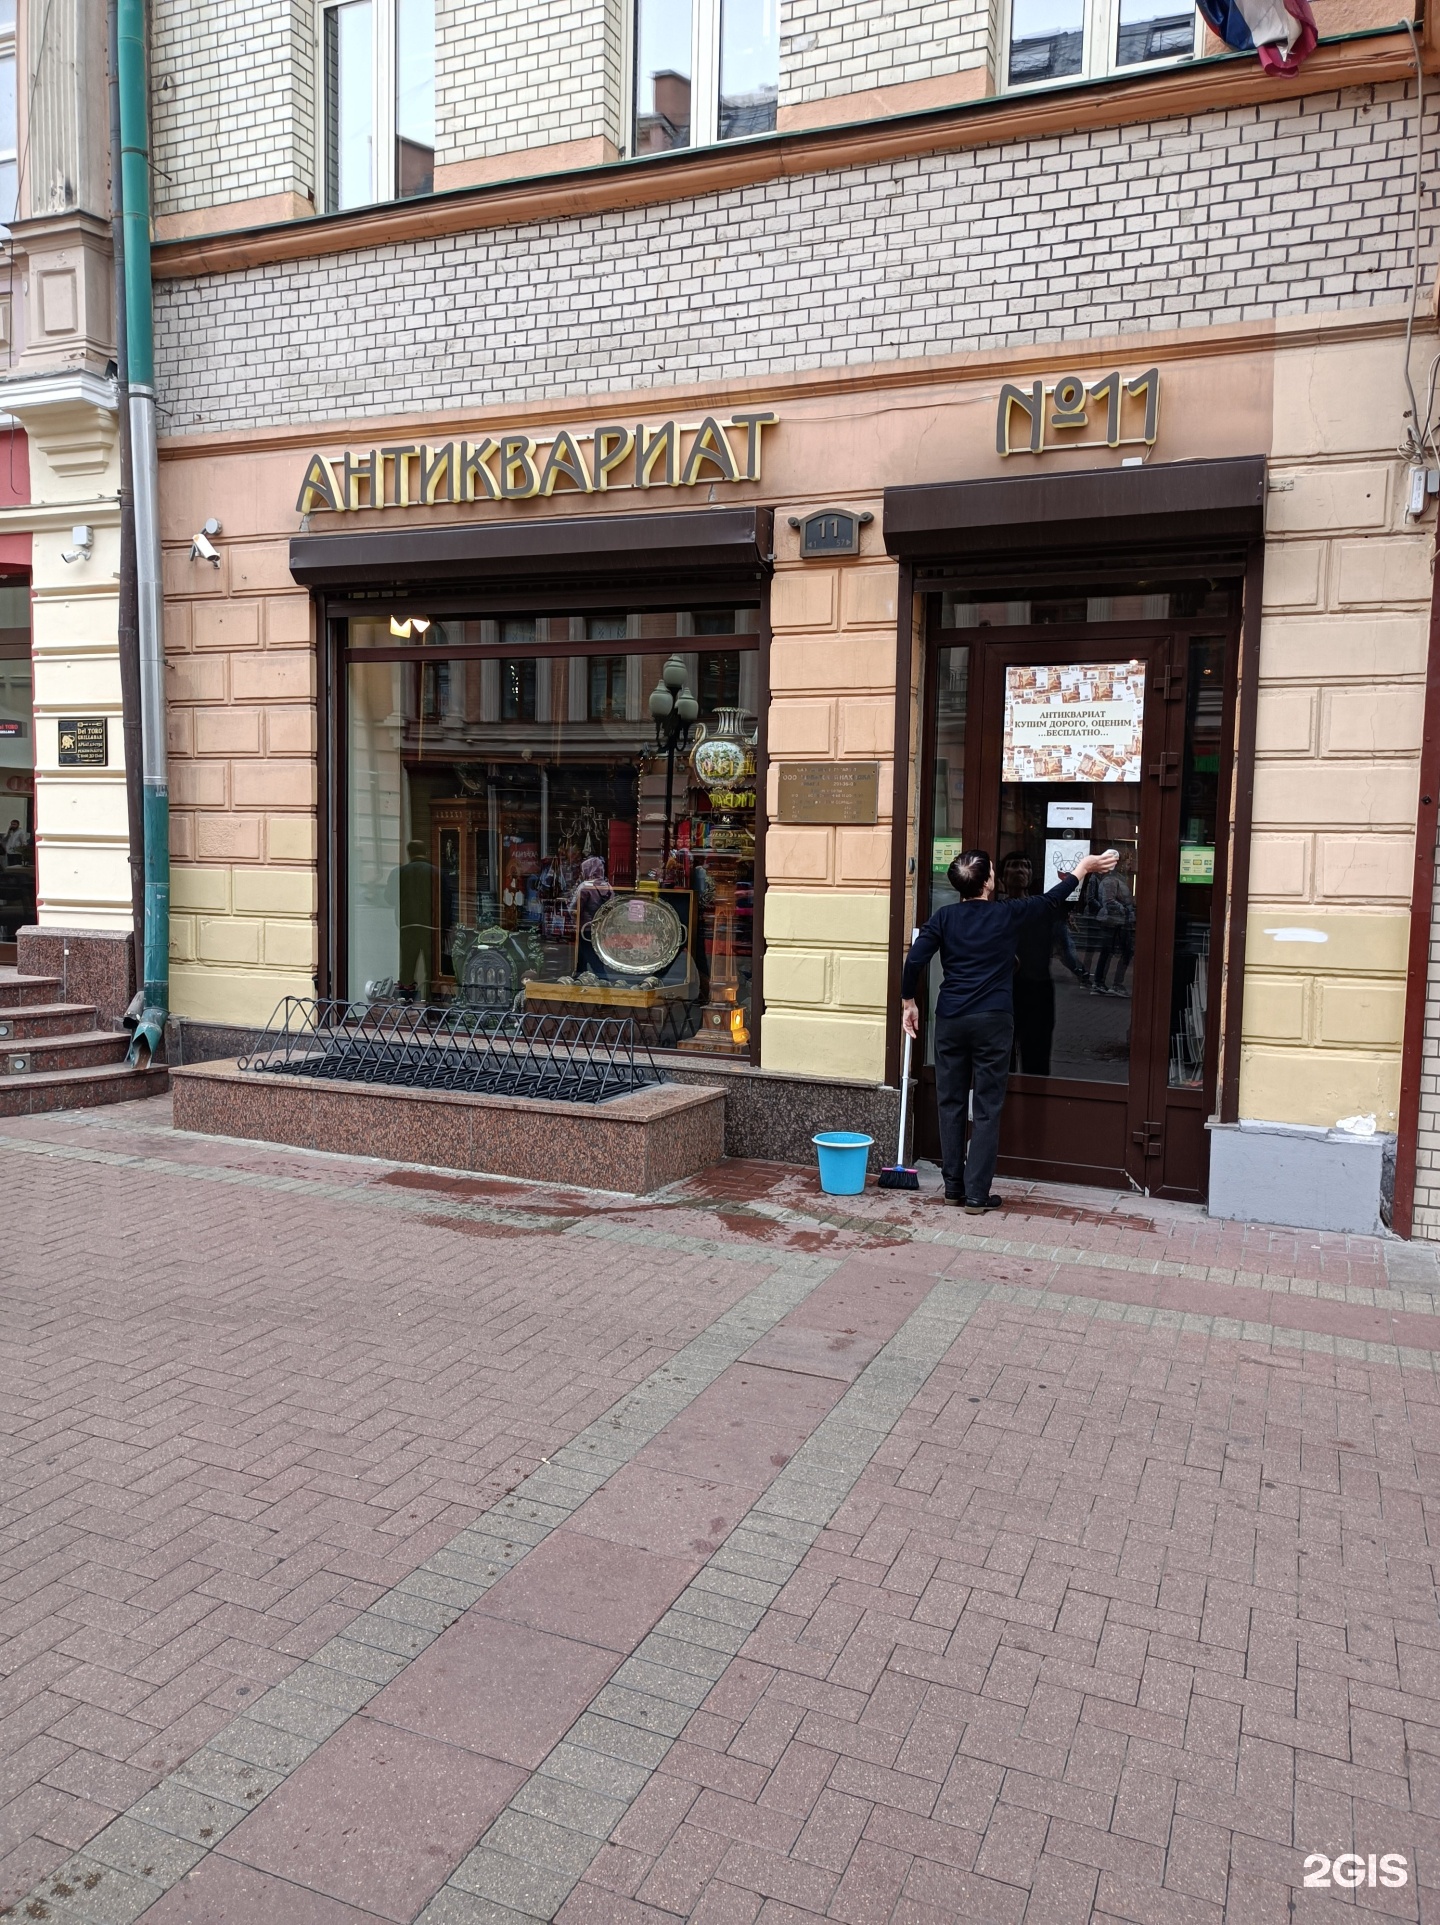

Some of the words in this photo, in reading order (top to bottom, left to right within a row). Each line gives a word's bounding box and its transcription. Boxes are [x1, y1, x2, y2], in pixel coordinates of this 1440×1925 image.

[295, 412, 780, 515] АНТИКВАРИАТ
[816, 518, 839, 539] 11
[1039, 710, 1106, 719] АНТИКВАРИАТ
[1014, 719, 1047, 728] КУПИМ
[1049, 719, 1089, 728] ДОРОГО,
[1091, 718, 1132, 727] ОЦЕНИМ
